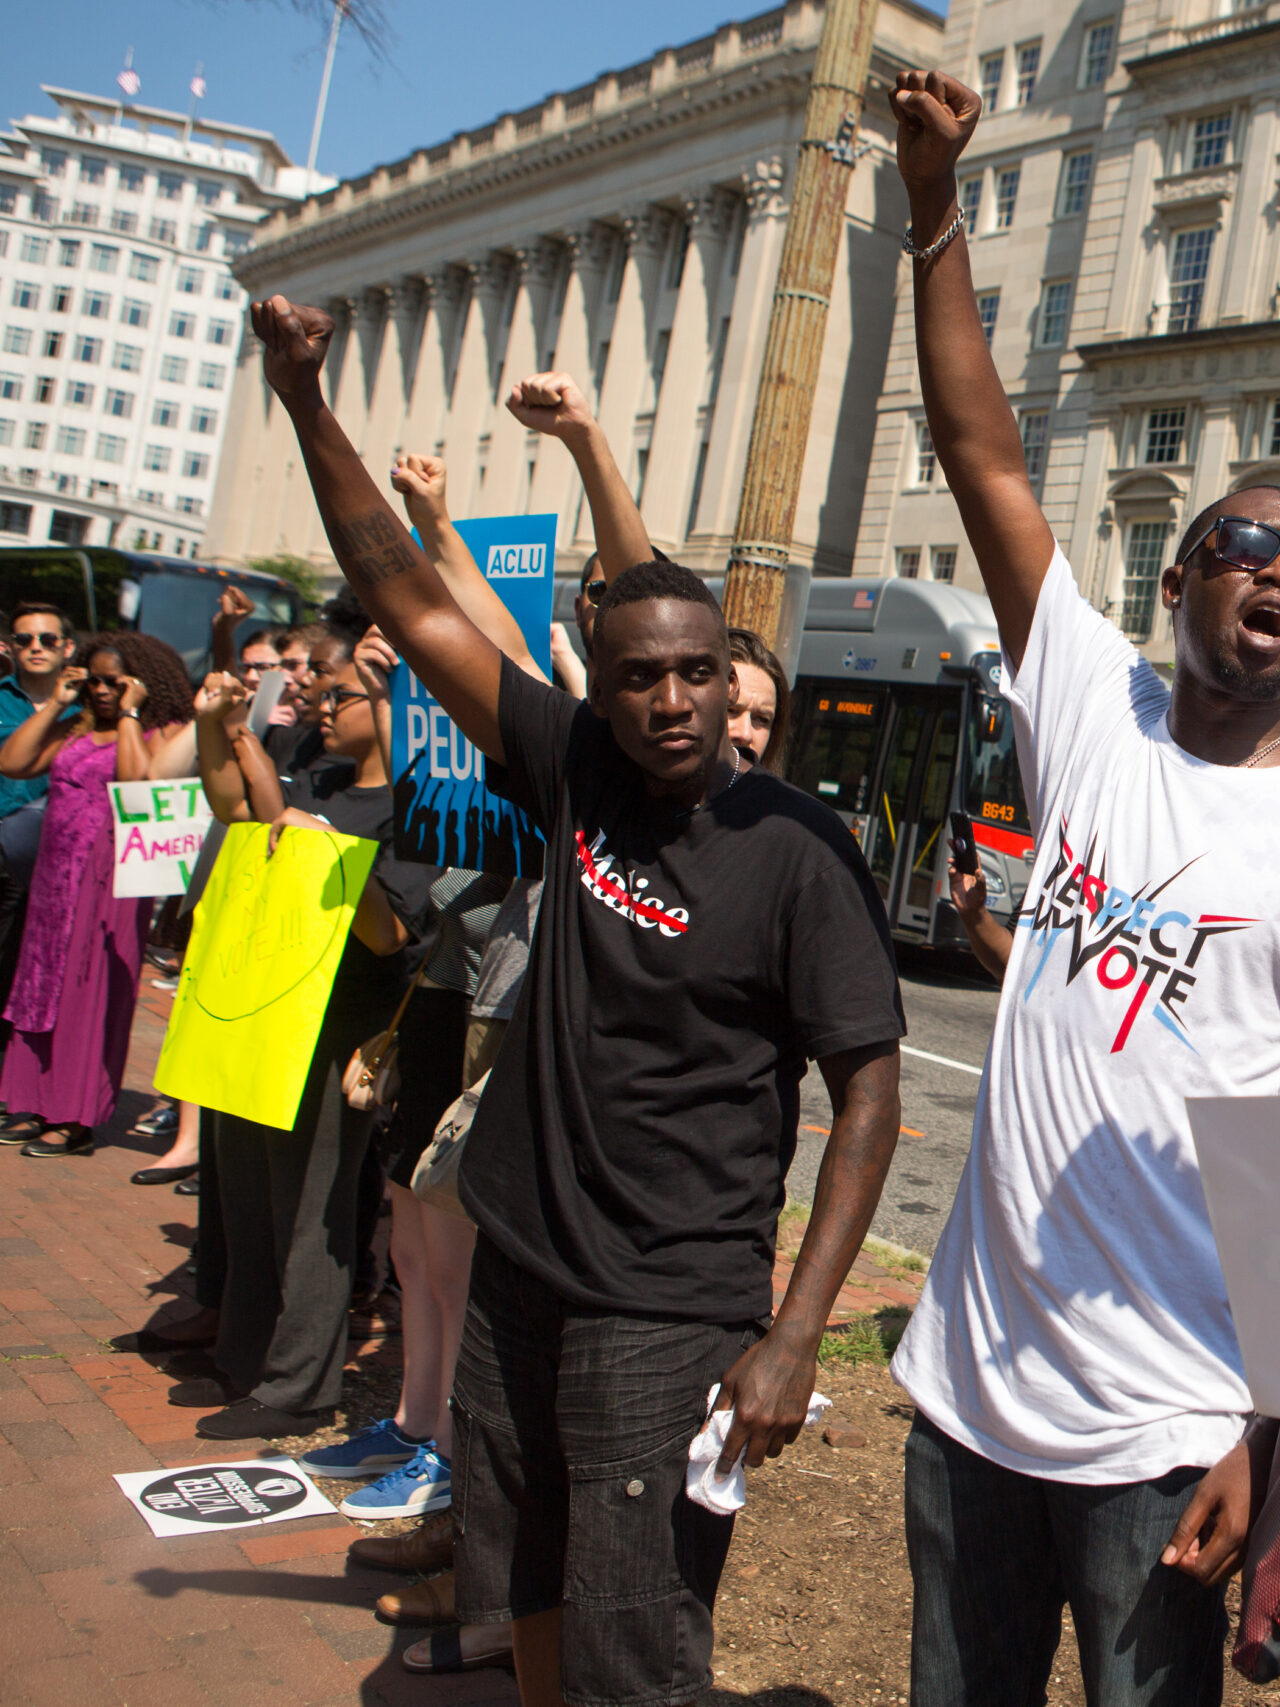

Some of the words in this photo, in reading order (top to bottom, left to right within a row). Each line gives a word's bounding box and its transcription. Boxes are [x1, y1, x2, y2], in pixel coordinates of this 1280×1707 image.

[490, 547, 543, 574] ACLU
[1066, 885, 1202, 1056] VOTE
[145, 1492, 190, 1511] END
[213, 1470, 272, 1514] SUPPRESSION
